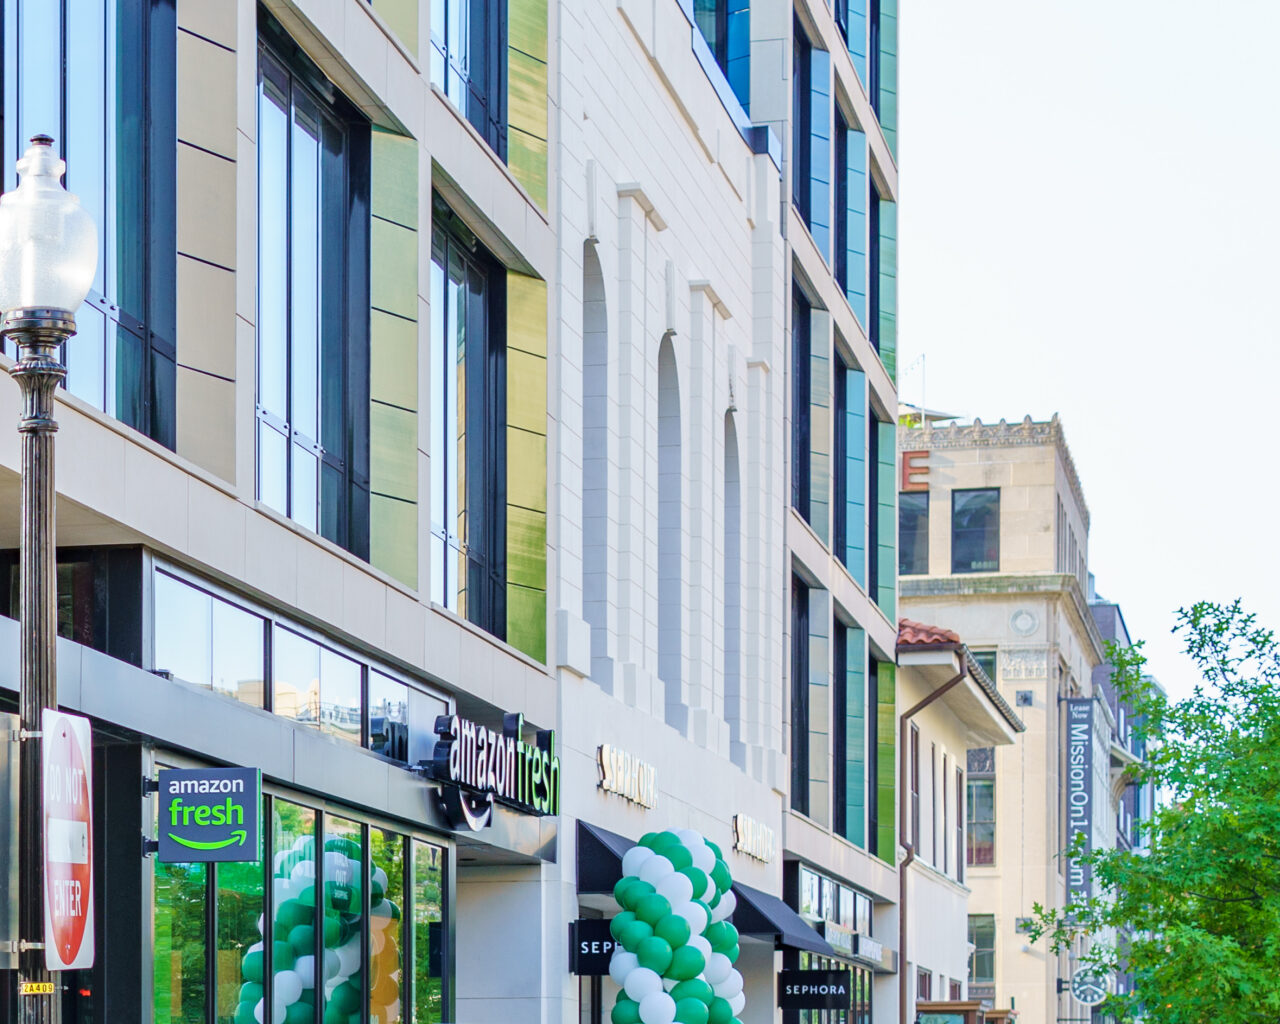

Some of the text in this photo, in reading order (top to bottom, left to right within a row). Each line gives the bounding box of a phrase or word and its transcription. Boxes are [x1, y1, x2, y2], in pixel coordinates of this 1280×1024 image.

[449, 714, 515, 800] amazon
[516, 712, 561, 817] fresh
[49, 763, 84, 805] DO NOT
[168, 779, 244, 794] amazon
[168, 797, 244, 826] fresh
[54, 880, 82, 917] ENTER
[786, 985, 846, 995] SEPHORA
